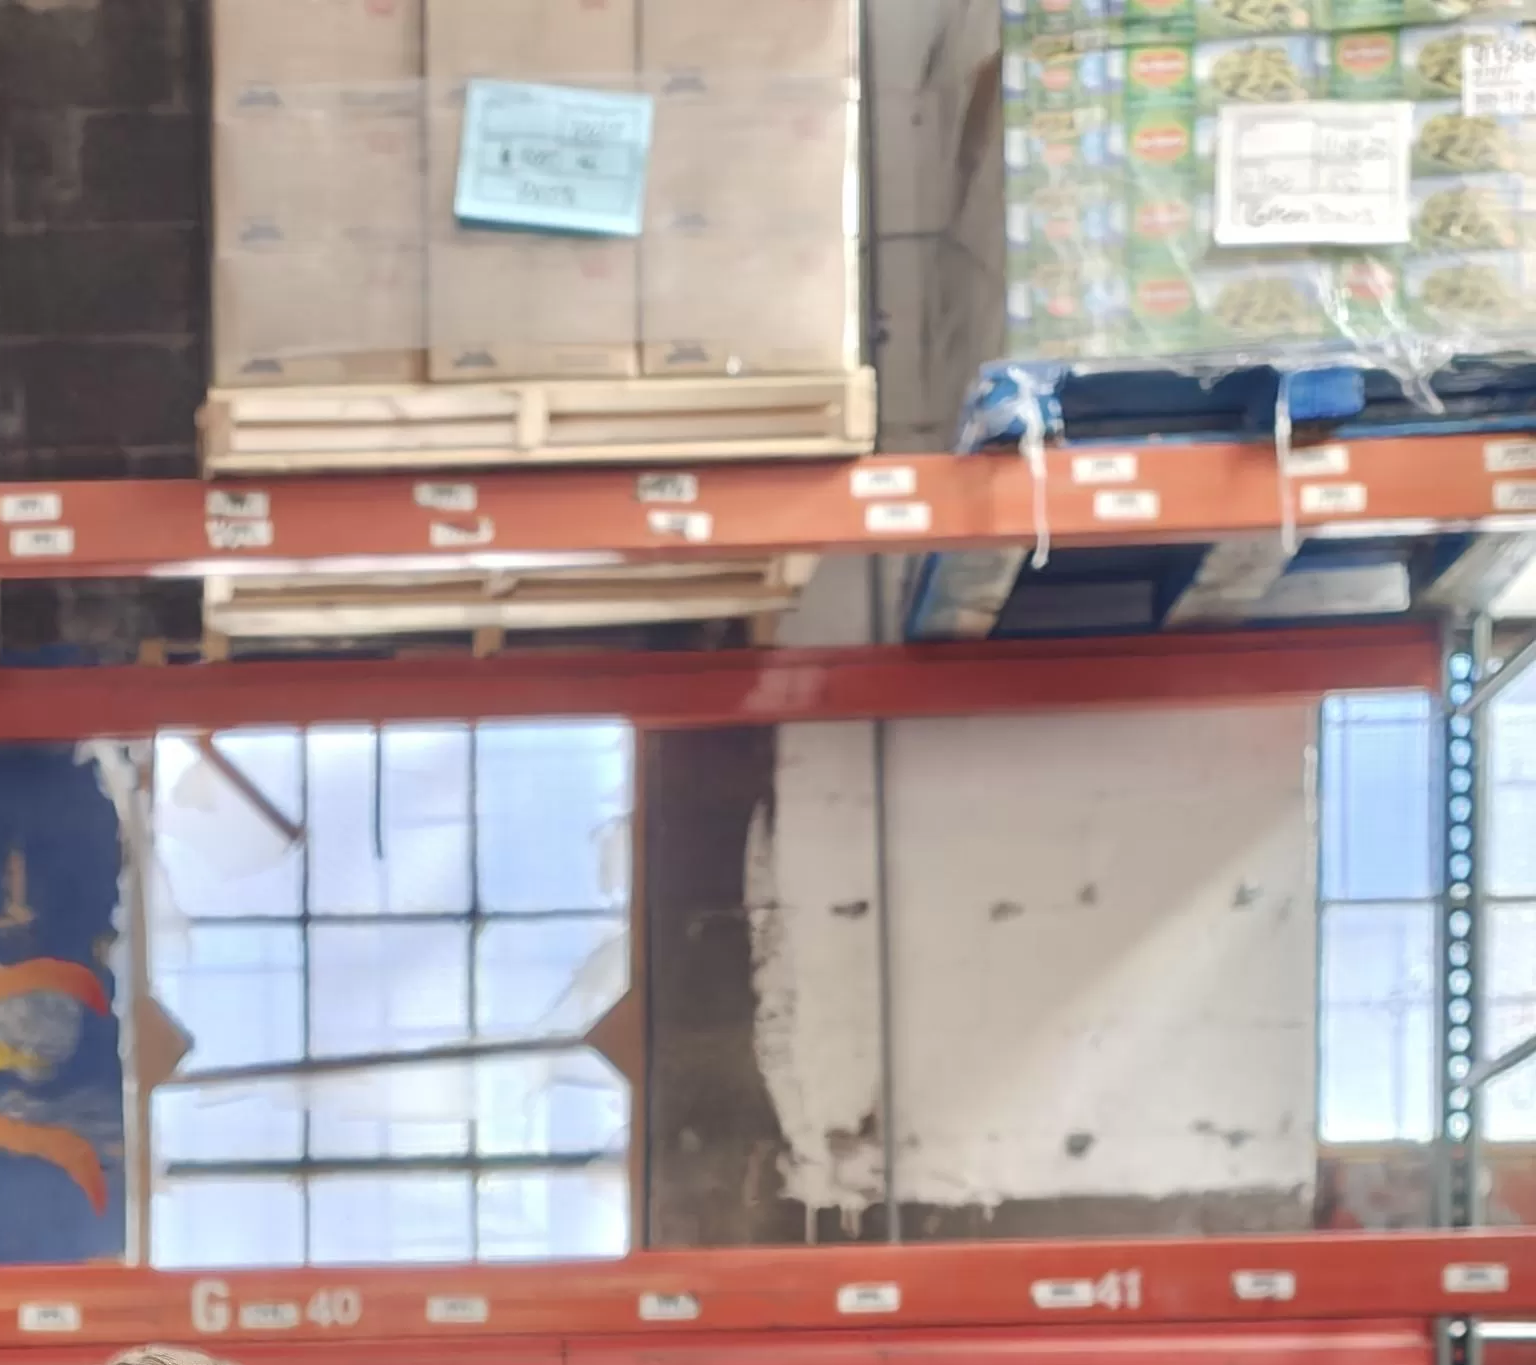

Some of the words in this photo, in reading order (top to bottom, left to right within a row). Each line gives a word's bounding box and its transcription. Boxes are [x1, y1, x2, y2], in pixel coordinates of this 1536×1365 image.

[191, 1280, 231, 1333] G
[306, 1289, 361, 1328] 40
[1094, 1271, 1141, 1310] 41
